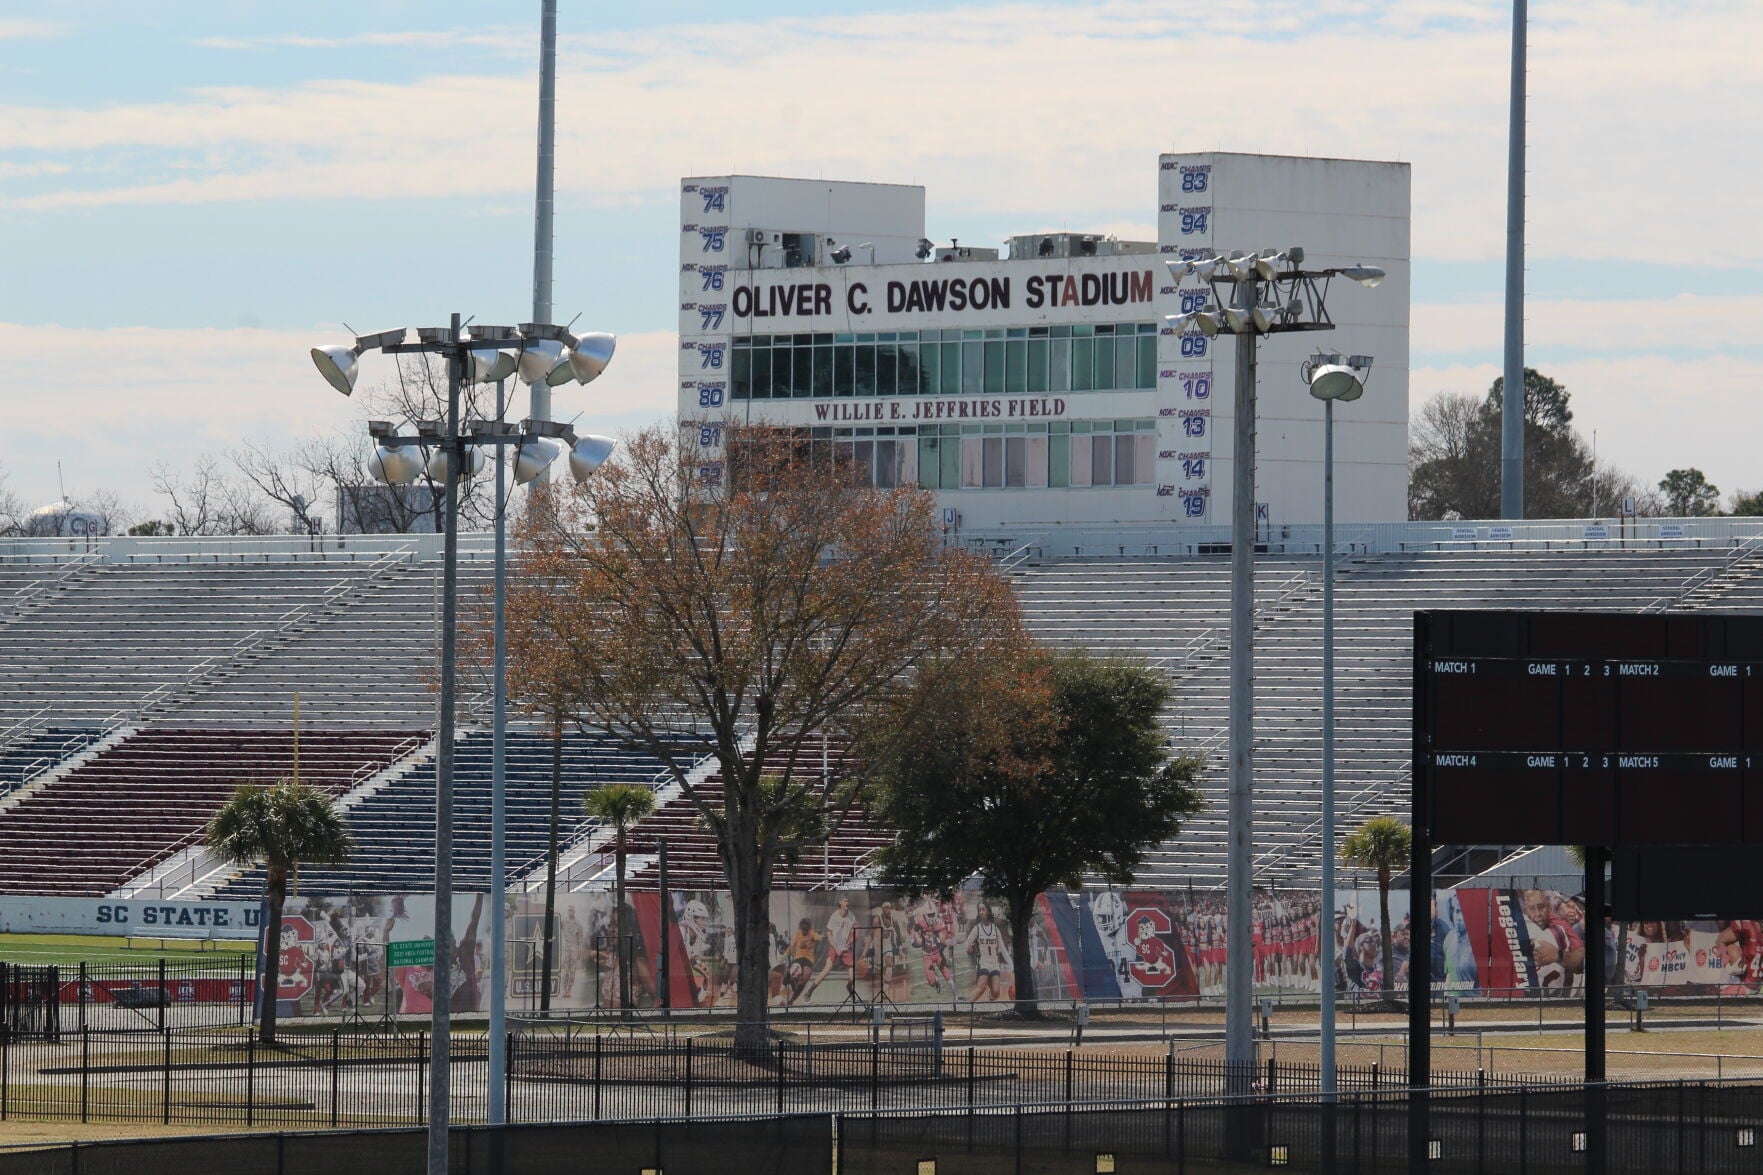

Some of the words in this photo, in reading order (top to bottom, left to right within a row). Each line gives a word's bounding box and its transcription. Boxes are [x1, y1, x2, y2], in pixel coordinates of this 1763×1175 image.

[1182, 173, 1208, 193] 83
[703, 193, 724, 213] 74
[1181, 214, 1207, 234] 94
[702, 233, 725, 252] 75
[702, 272, 724, 291] 76
[732, 283, 832, 318] OLIVER
[848, 282, 872, 315] C.
[887, 276, 1010, 313] DAWSON
[1026, 270, 1153, 308] STADIUM
[701, 311, 724, 330] 77
[1181, 337, 1207, 357] 09
[701, 350, 723, 369] 78
[699, 389, 724, 408] 80
[1184, 380, 1210, 400] 10
[815, 402, 884, 421] WILLIE
[890, 402, 906, 420] E.
[912, 400, 1001, 420] JEFFRIES
[1008, 398, 1065, 417] FIELD
[1183, 417, 1205, 437] 13
[1183, 460, 1205, 480] 14
[1184, 497, 1205, 517] 19
[1258, 504, 1266, 519] K
[1625, 500, 1632, 513] L
[948, 510, 953, 523] J
[1435, 662, 1467, 673] MATCH
[1471, 662, 1476, 673] 1
[1528, 664, 1556, 675] GAME
[1565, 665, 1569, 675] 1
[1584, 665, 1590, 675] 2
[1604, 665, 1610, 676] 3
[1620, 664, 1651, 675] MATCH
[1653, 665, 1659, 675] 2
[1710, 665, 1737, 676] GAME
[1746, 666, 1750, 676] 1
[1436, 755, 1468, 766] MATCH
[1470, 755, 1476, 766] 4
[1527, 756, 1555, 767] GAME
[1564, 757, 1569, 767] 1
[1583, 757, 1589, 767] 2
[1603, 757, 1608, 767] 3
[1619, 757, 1651, 767] MATCH
[1653, 757, 1658, 767] 5
[1709, 757, 1737, 768] GAME
[1746, 758, 1750, 767] 1
[96, 906, 129, 923] SC
[143, 907, 229, 926] STATE
[1141, 944, 1150, 954] SC
[1495, 896, 1530, 991] Legendary
[1661, 961, 1686, 973] HBCU
